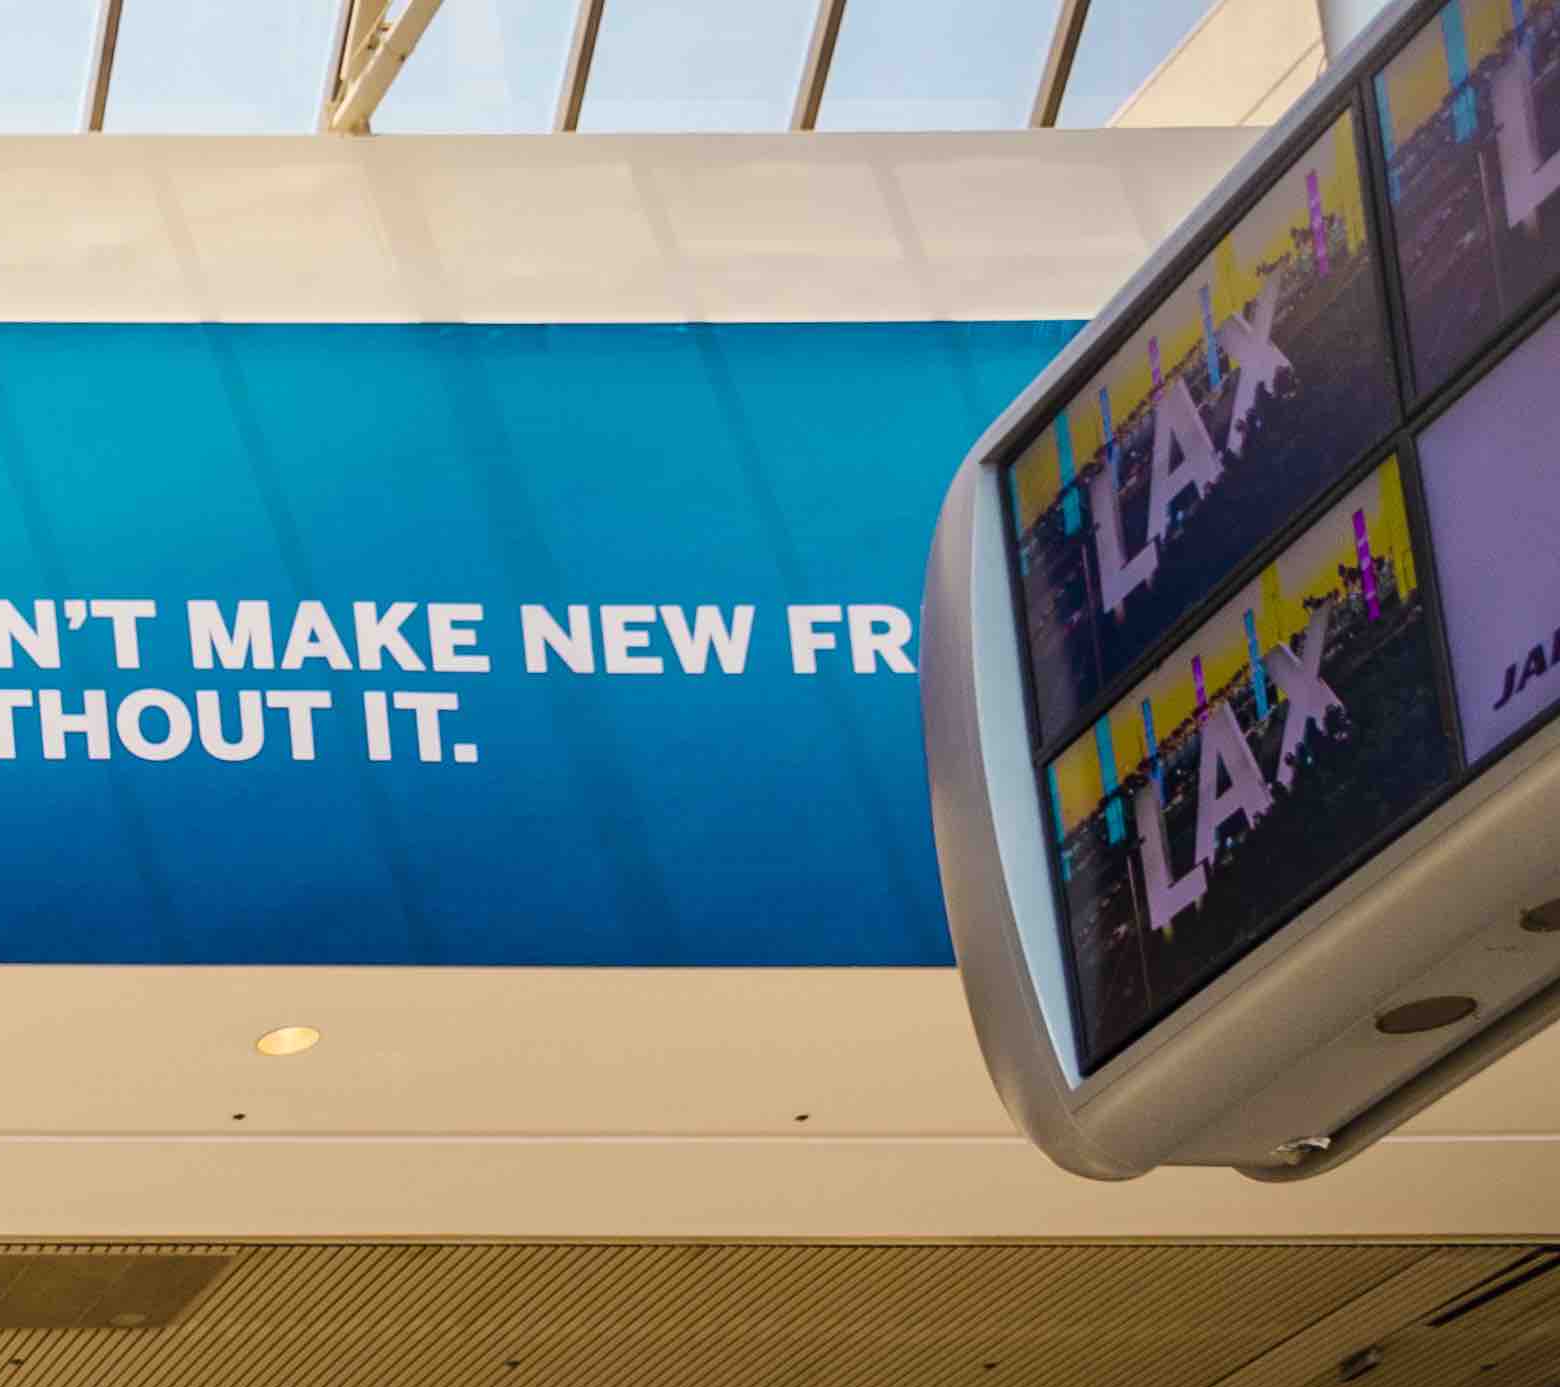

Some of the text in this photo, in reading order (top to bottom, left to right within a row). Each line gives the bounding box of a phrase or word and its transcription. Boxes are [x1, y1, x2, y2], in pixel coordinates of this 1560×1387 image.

[1090, 272, 1292, 617] LAX
[187, 600, 490, 673] MAKE
[520, 603, 754, 674] NEW
[787, 605, 918, 676] FR
[362, 690, 479, 764] IT.
[1136, 609, 1345, 933] LAX
